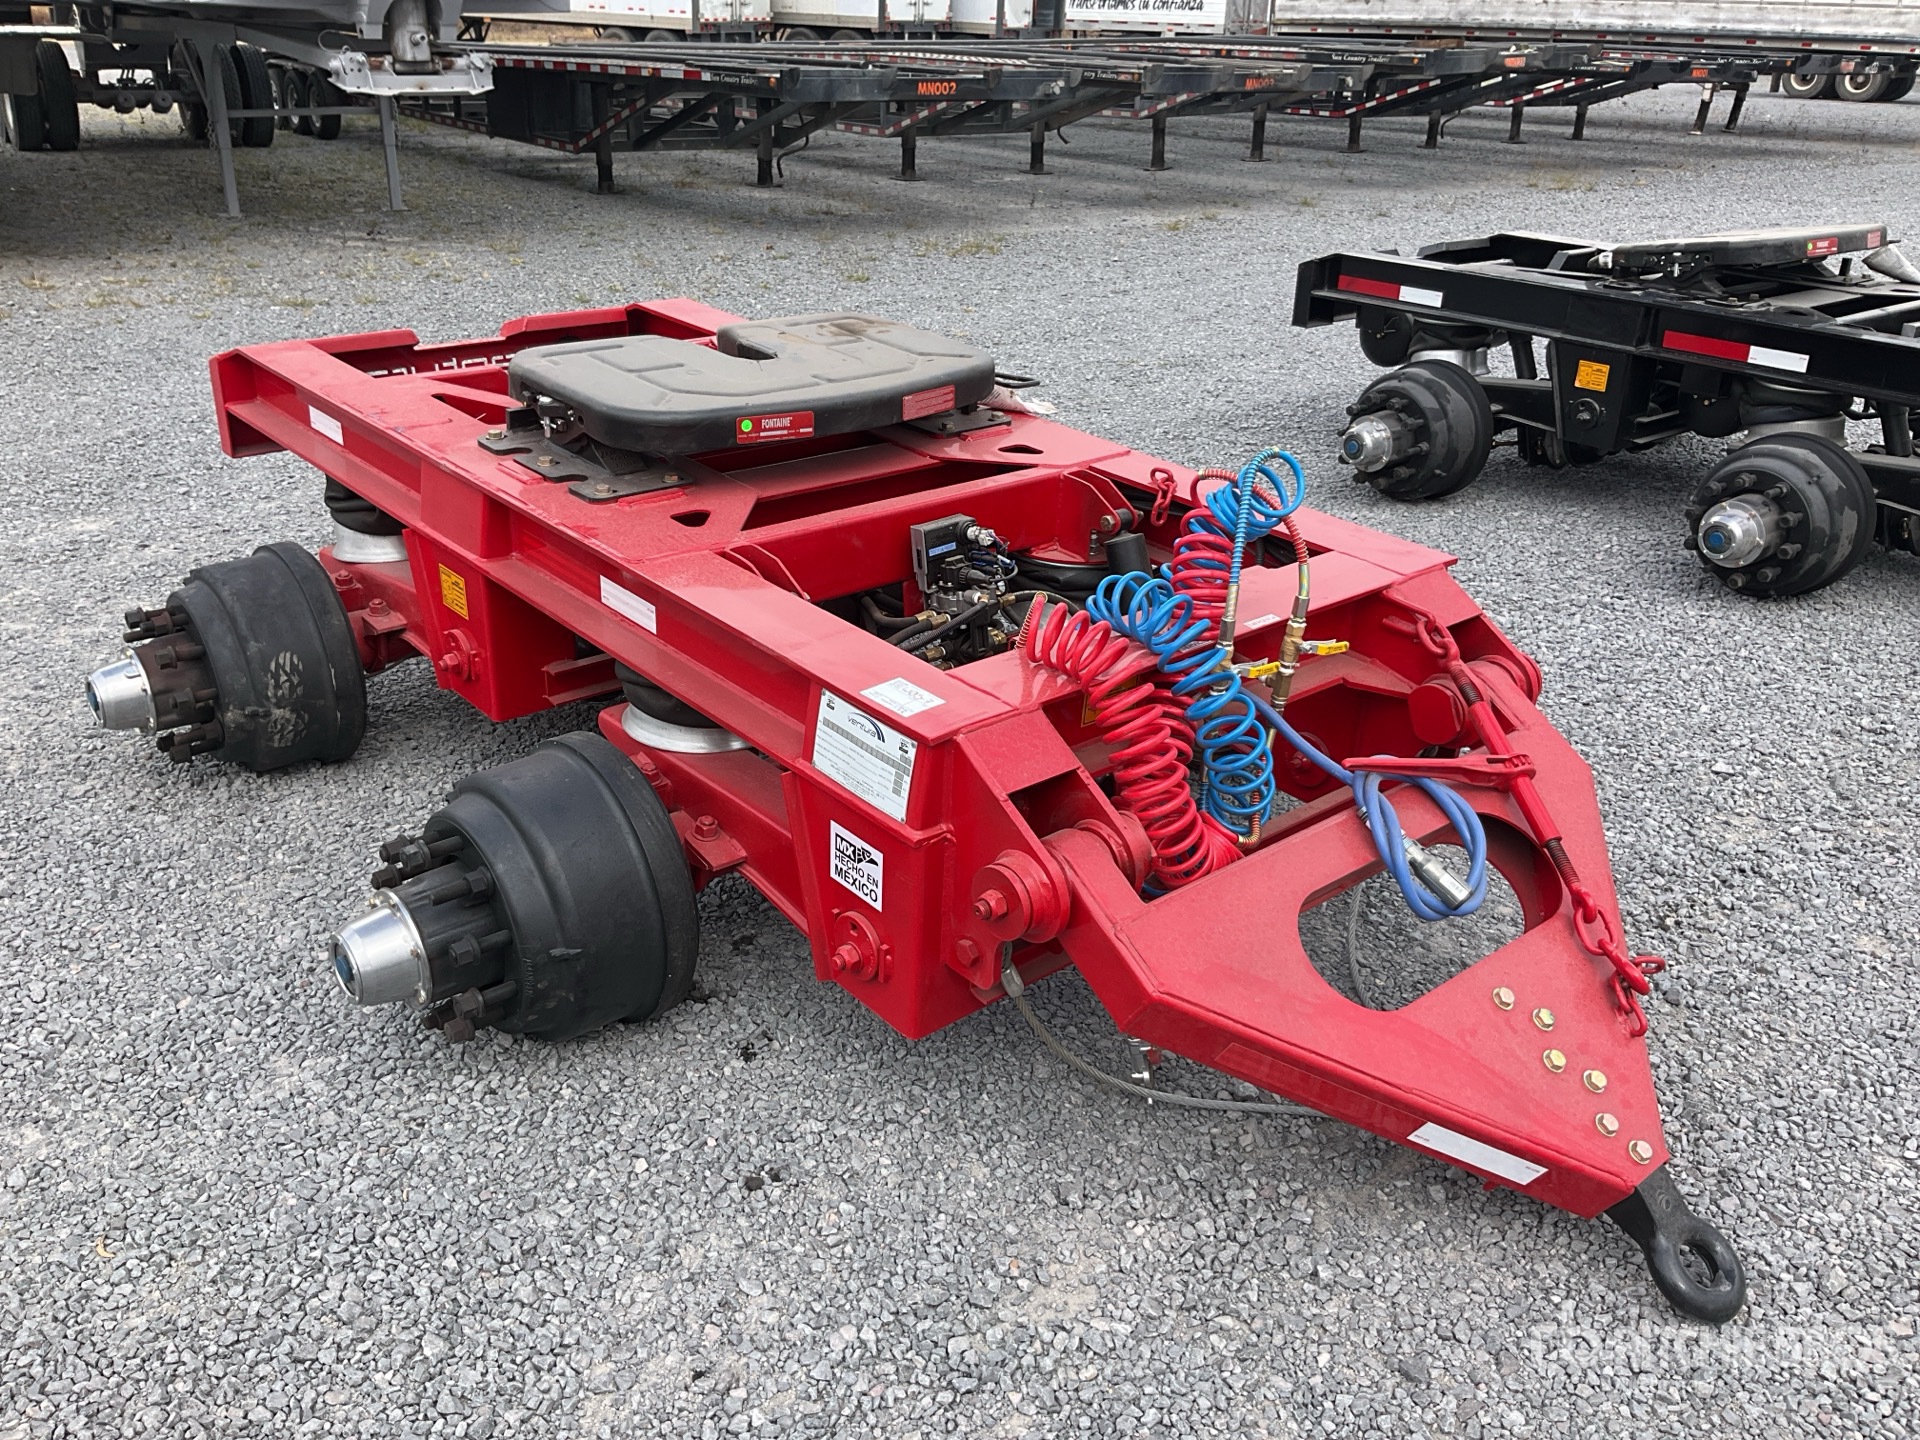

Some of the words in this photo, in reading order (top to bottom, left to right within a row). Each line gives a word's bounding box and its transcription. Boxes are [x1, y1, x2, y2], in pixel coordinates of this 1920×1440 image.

[917, 81, 957, 95] MN002
[761, 417, 792, 430] FONTAINE
[848, 715, 877, 738] ventura
[836, 834, 856, 863] MX
[834, 850, 865, 879] HECHO
[866, 872, 879, 890] EN
